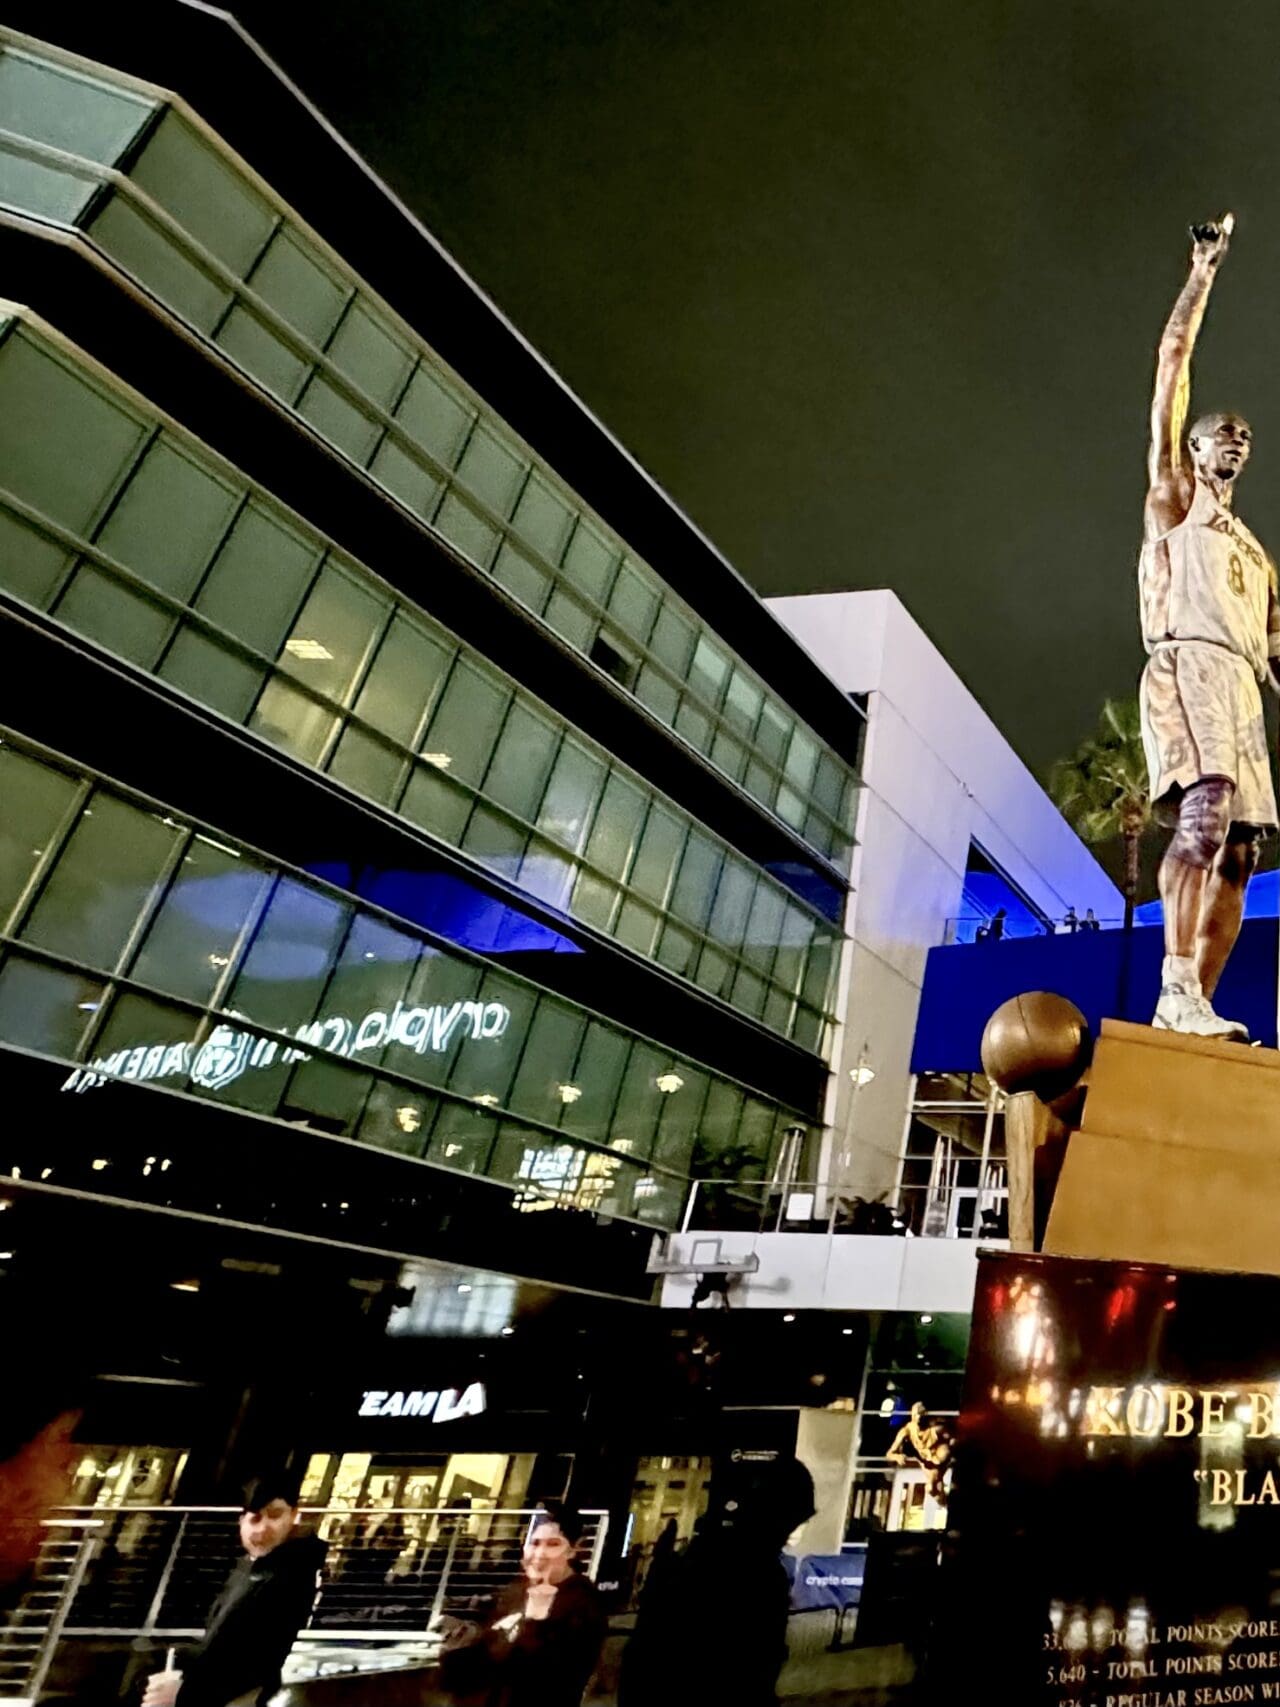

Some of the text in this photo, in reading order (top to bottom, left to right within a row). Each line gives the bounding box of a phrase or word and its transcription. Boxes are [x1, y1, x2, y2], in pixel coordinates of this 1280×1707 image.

[1086, 1385, 1228, 1438] KOBE
[1111, 1627, 1161, 1647] TOAL
[1167, 1622, 1223, 1643] POINTS
[1165, 1654, 1222, 1675] POINTS
[1106, 1690, 1187, 1707] REGULAR
[1195, 1684, 1255, 1705] SEASON
